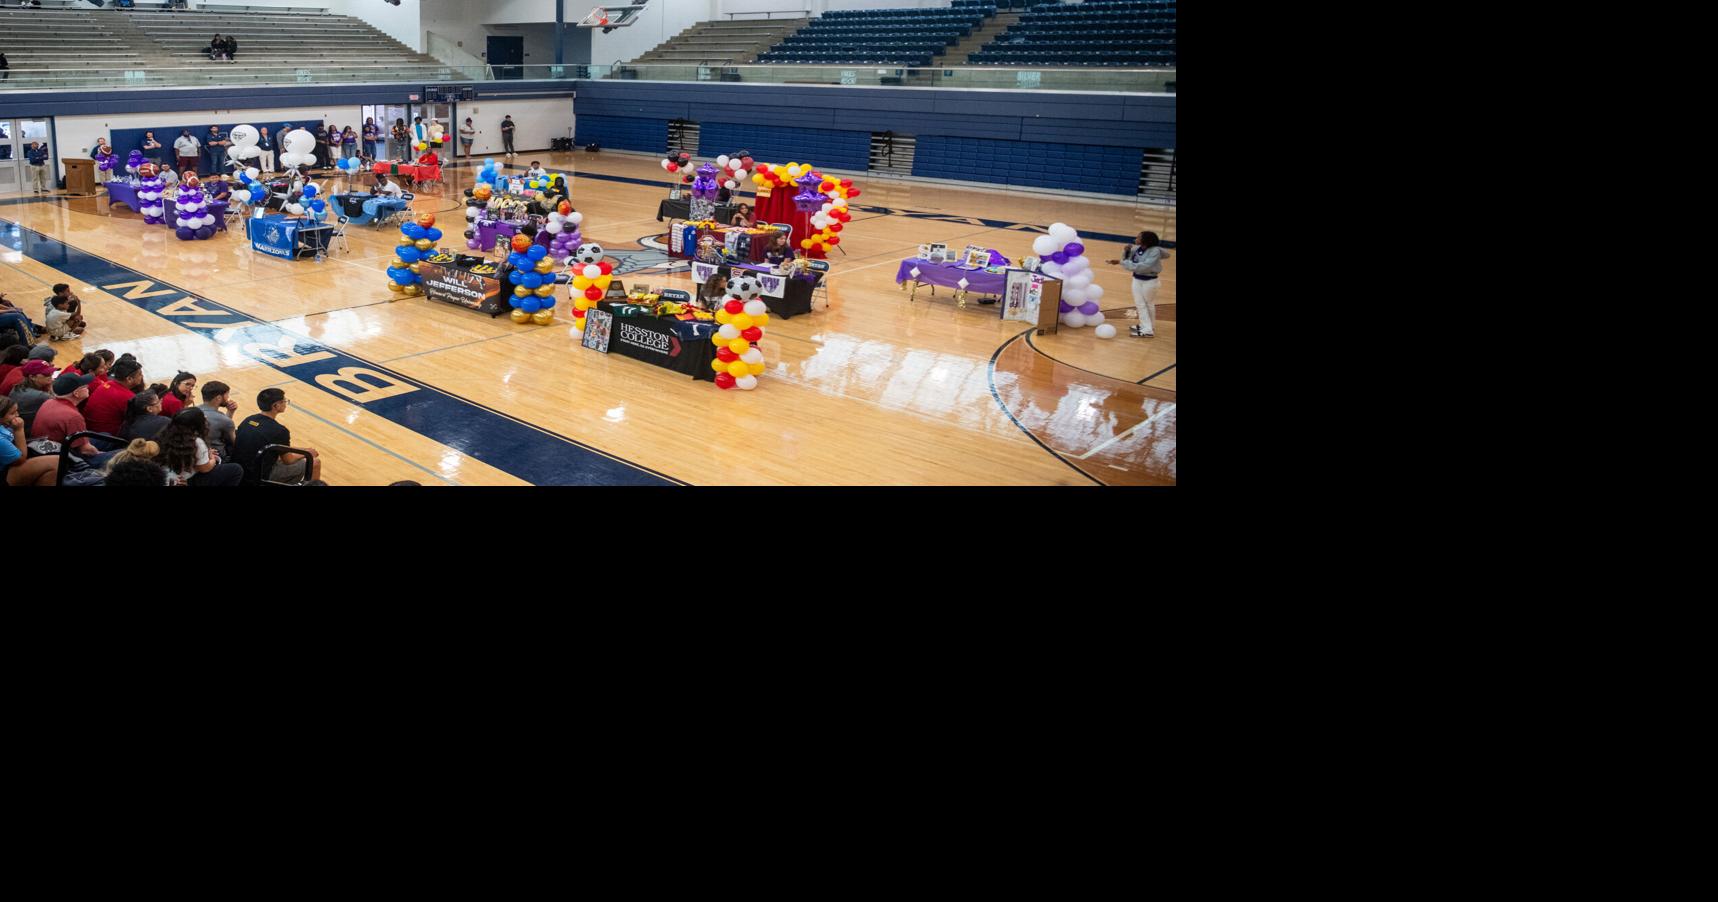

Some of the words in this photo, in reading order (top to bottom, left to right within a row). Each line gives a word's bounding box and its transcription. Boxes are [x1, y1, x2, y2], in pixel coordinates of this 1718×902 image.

[426, 280, 486, 300] JEFFERSON
[443, 275, 468, 288] WILL
[101, 279, 422, 403] BRYAN
[620, 322, 669, 342] HESSTON
[620, 330, 669, 351] COLLEGE
